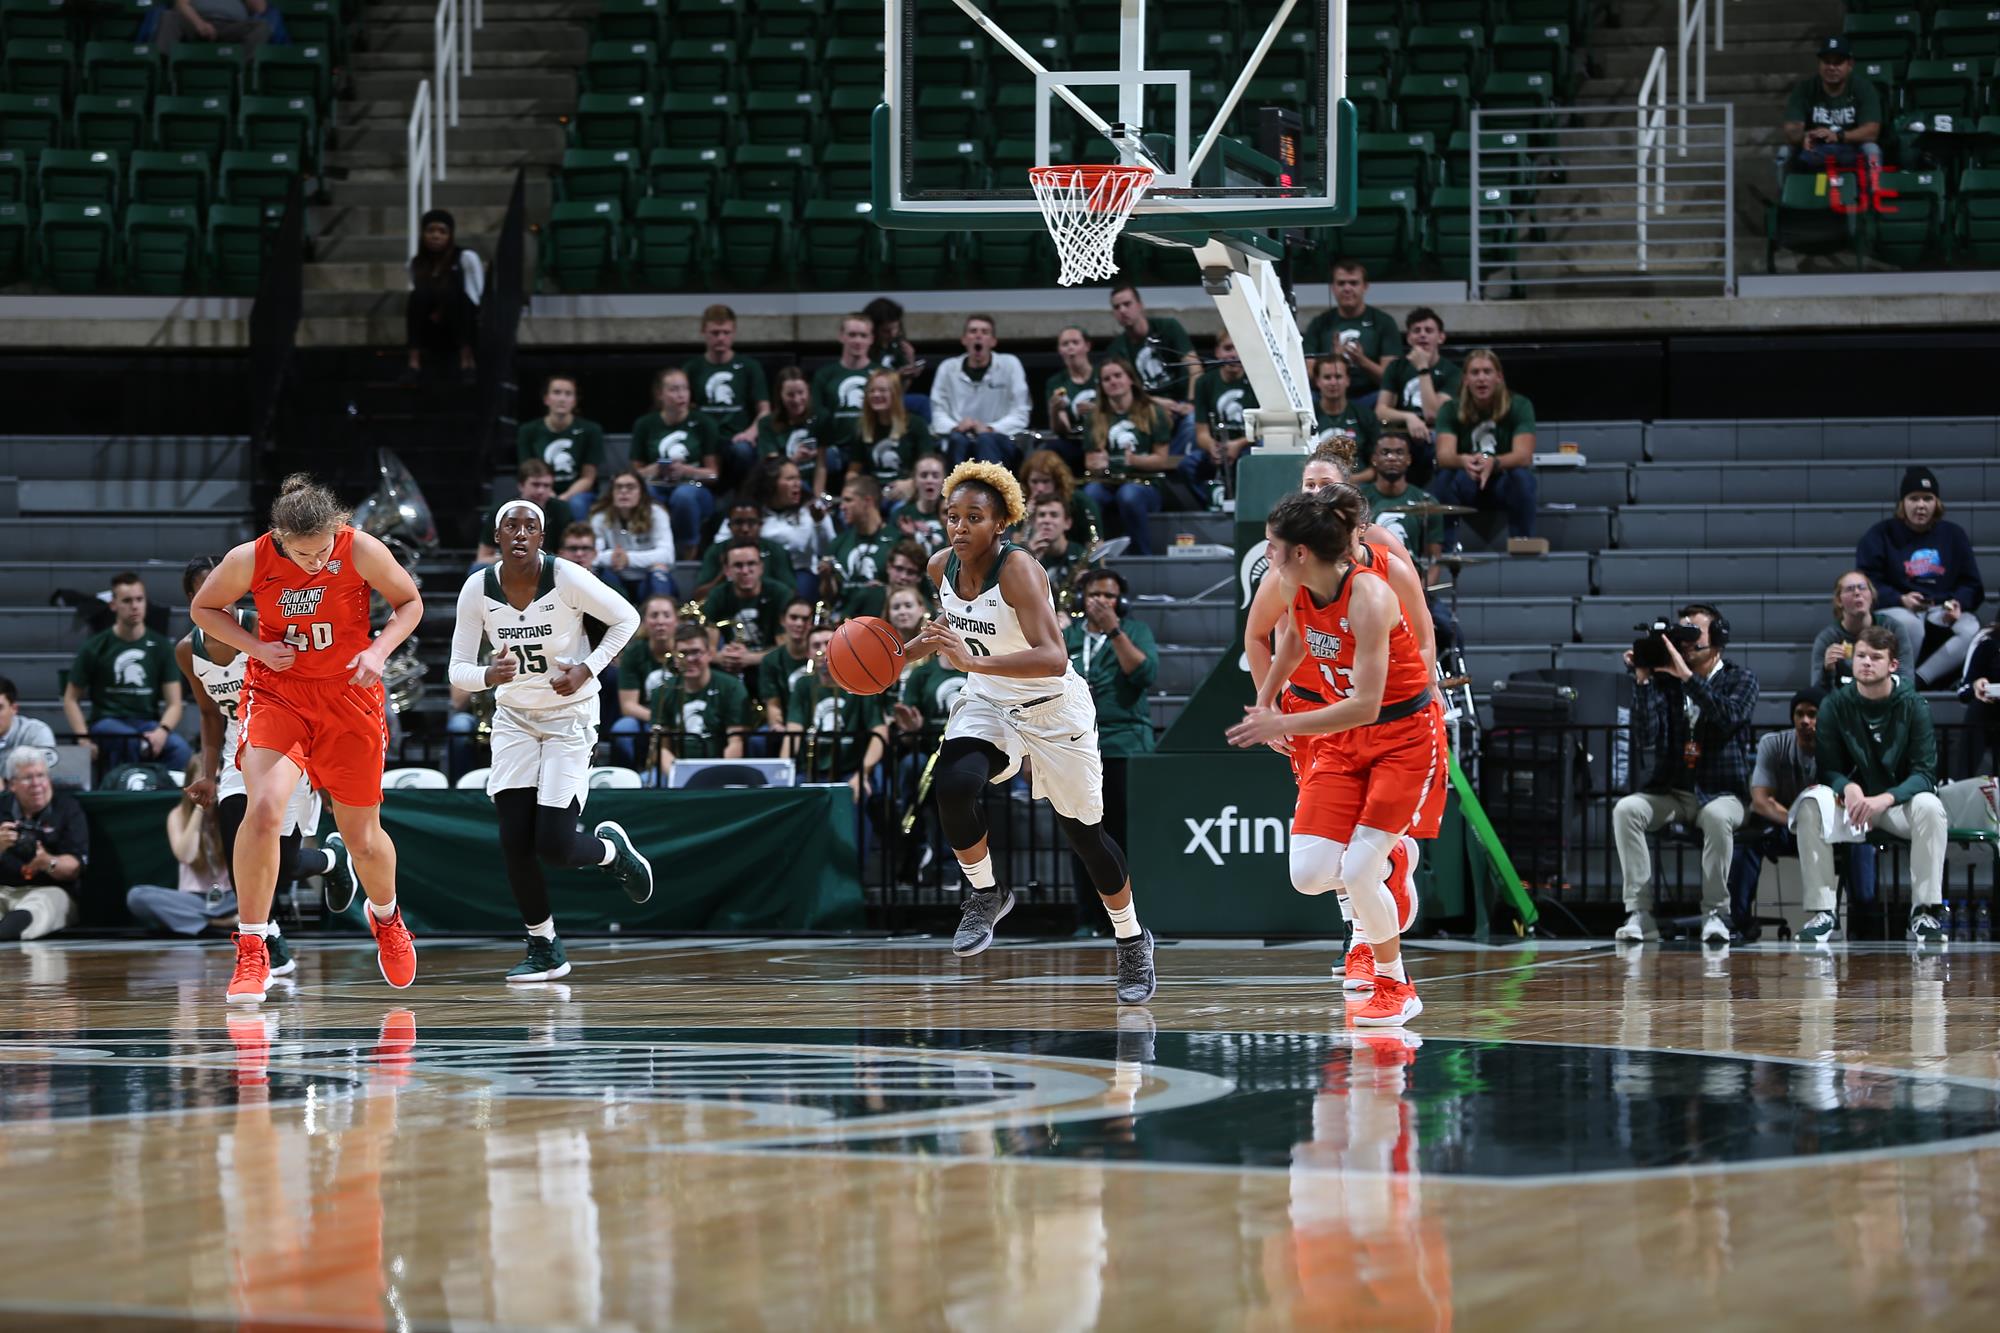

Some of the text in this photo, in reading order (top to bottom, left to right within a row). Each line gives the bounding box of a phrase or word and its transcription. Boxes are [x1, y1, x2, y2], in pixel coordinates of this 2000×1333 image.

[280, 589, 322, 604] BOWLING
[284, 602, 315, 616] GREEN
[497, 623, 553, 640] SPARTANS
[948, 612, 996, 635] SPARTANS
[283, 622, 334, 652] 40
[1306, 628, 1340, 650] BOWLING
[509, 643, 549, 675] 15
[1183, 804, 1296, 866] xfin
